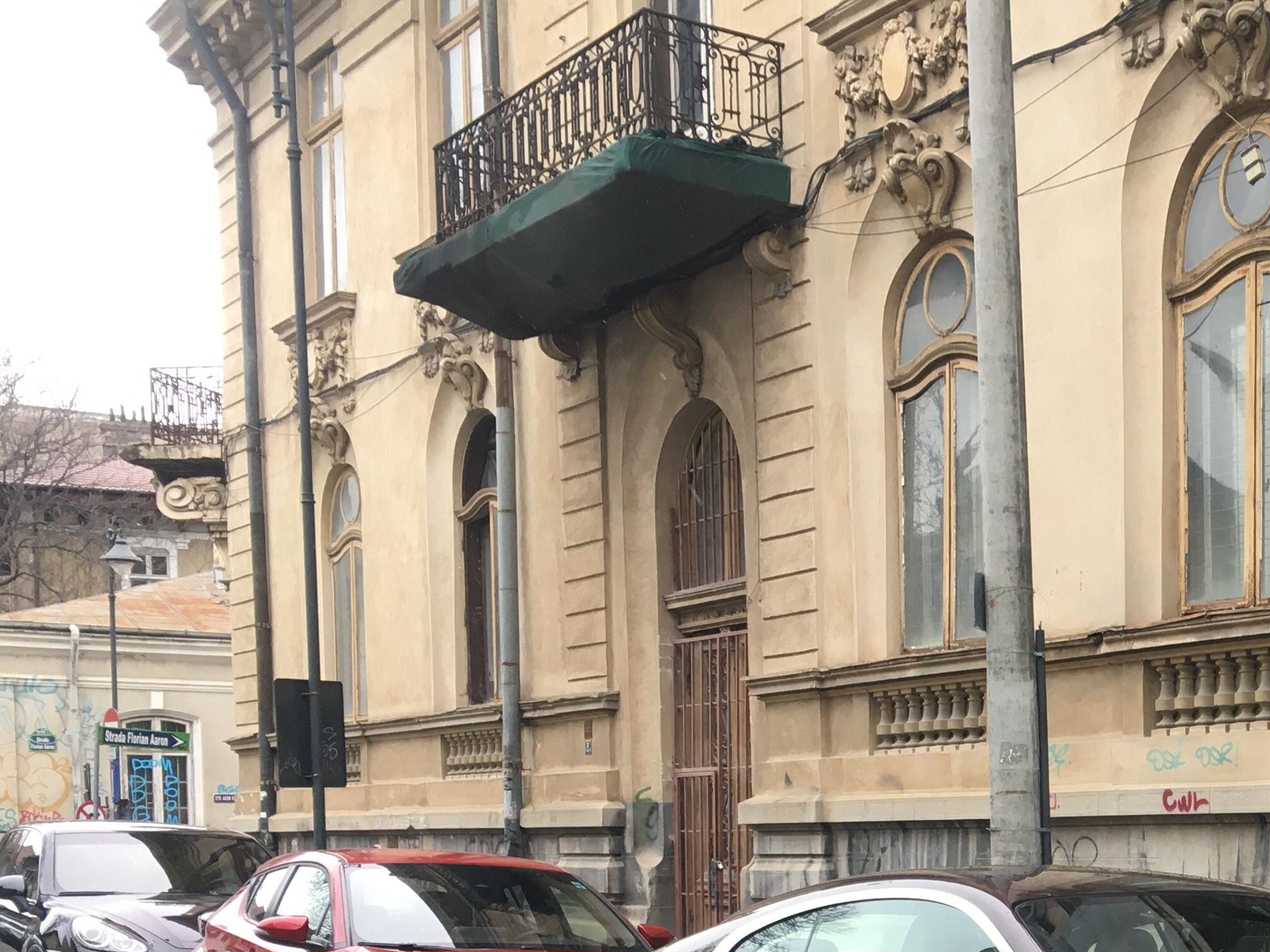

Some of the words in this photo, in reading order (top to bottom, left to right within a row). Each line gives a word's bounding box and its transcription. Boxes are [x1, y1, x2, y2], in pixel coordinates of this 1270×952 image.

[105, 729, 126, 744] Strada
[127, 731, 149, 745] Florian
[149, 733, 169, 747] Aaron
